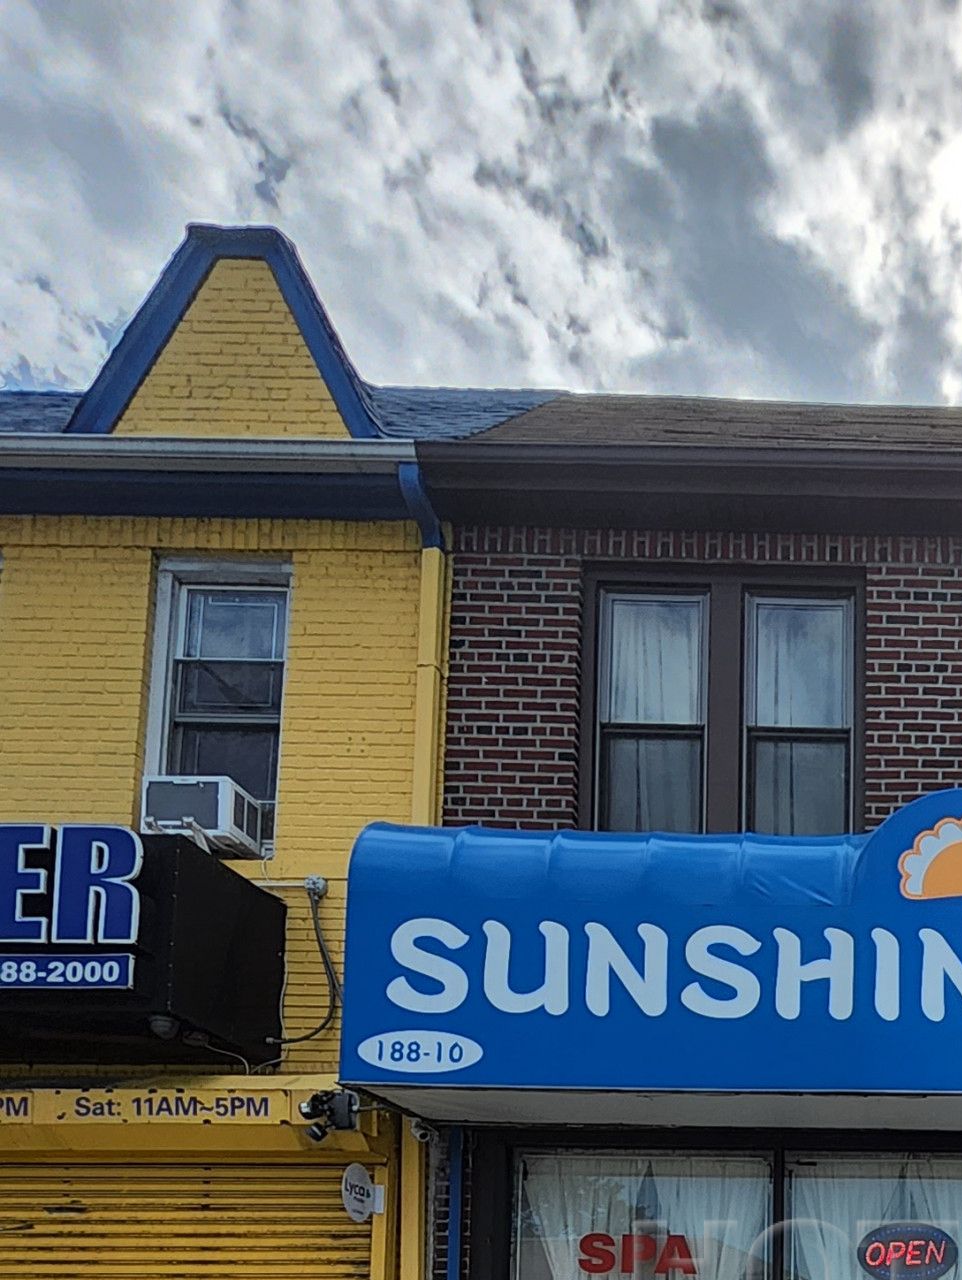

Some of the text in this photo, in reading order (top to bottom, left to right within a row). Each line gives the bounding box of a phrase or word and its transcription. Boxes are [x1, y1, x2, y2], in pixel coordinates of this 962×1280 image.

[375, 1040, 464, 1064] 188-10
[74, 1096, 122, 1117] Sat:
[578, 1233, 698, 1275] SPA
[865, 1240, 946, 1266] OPEN
